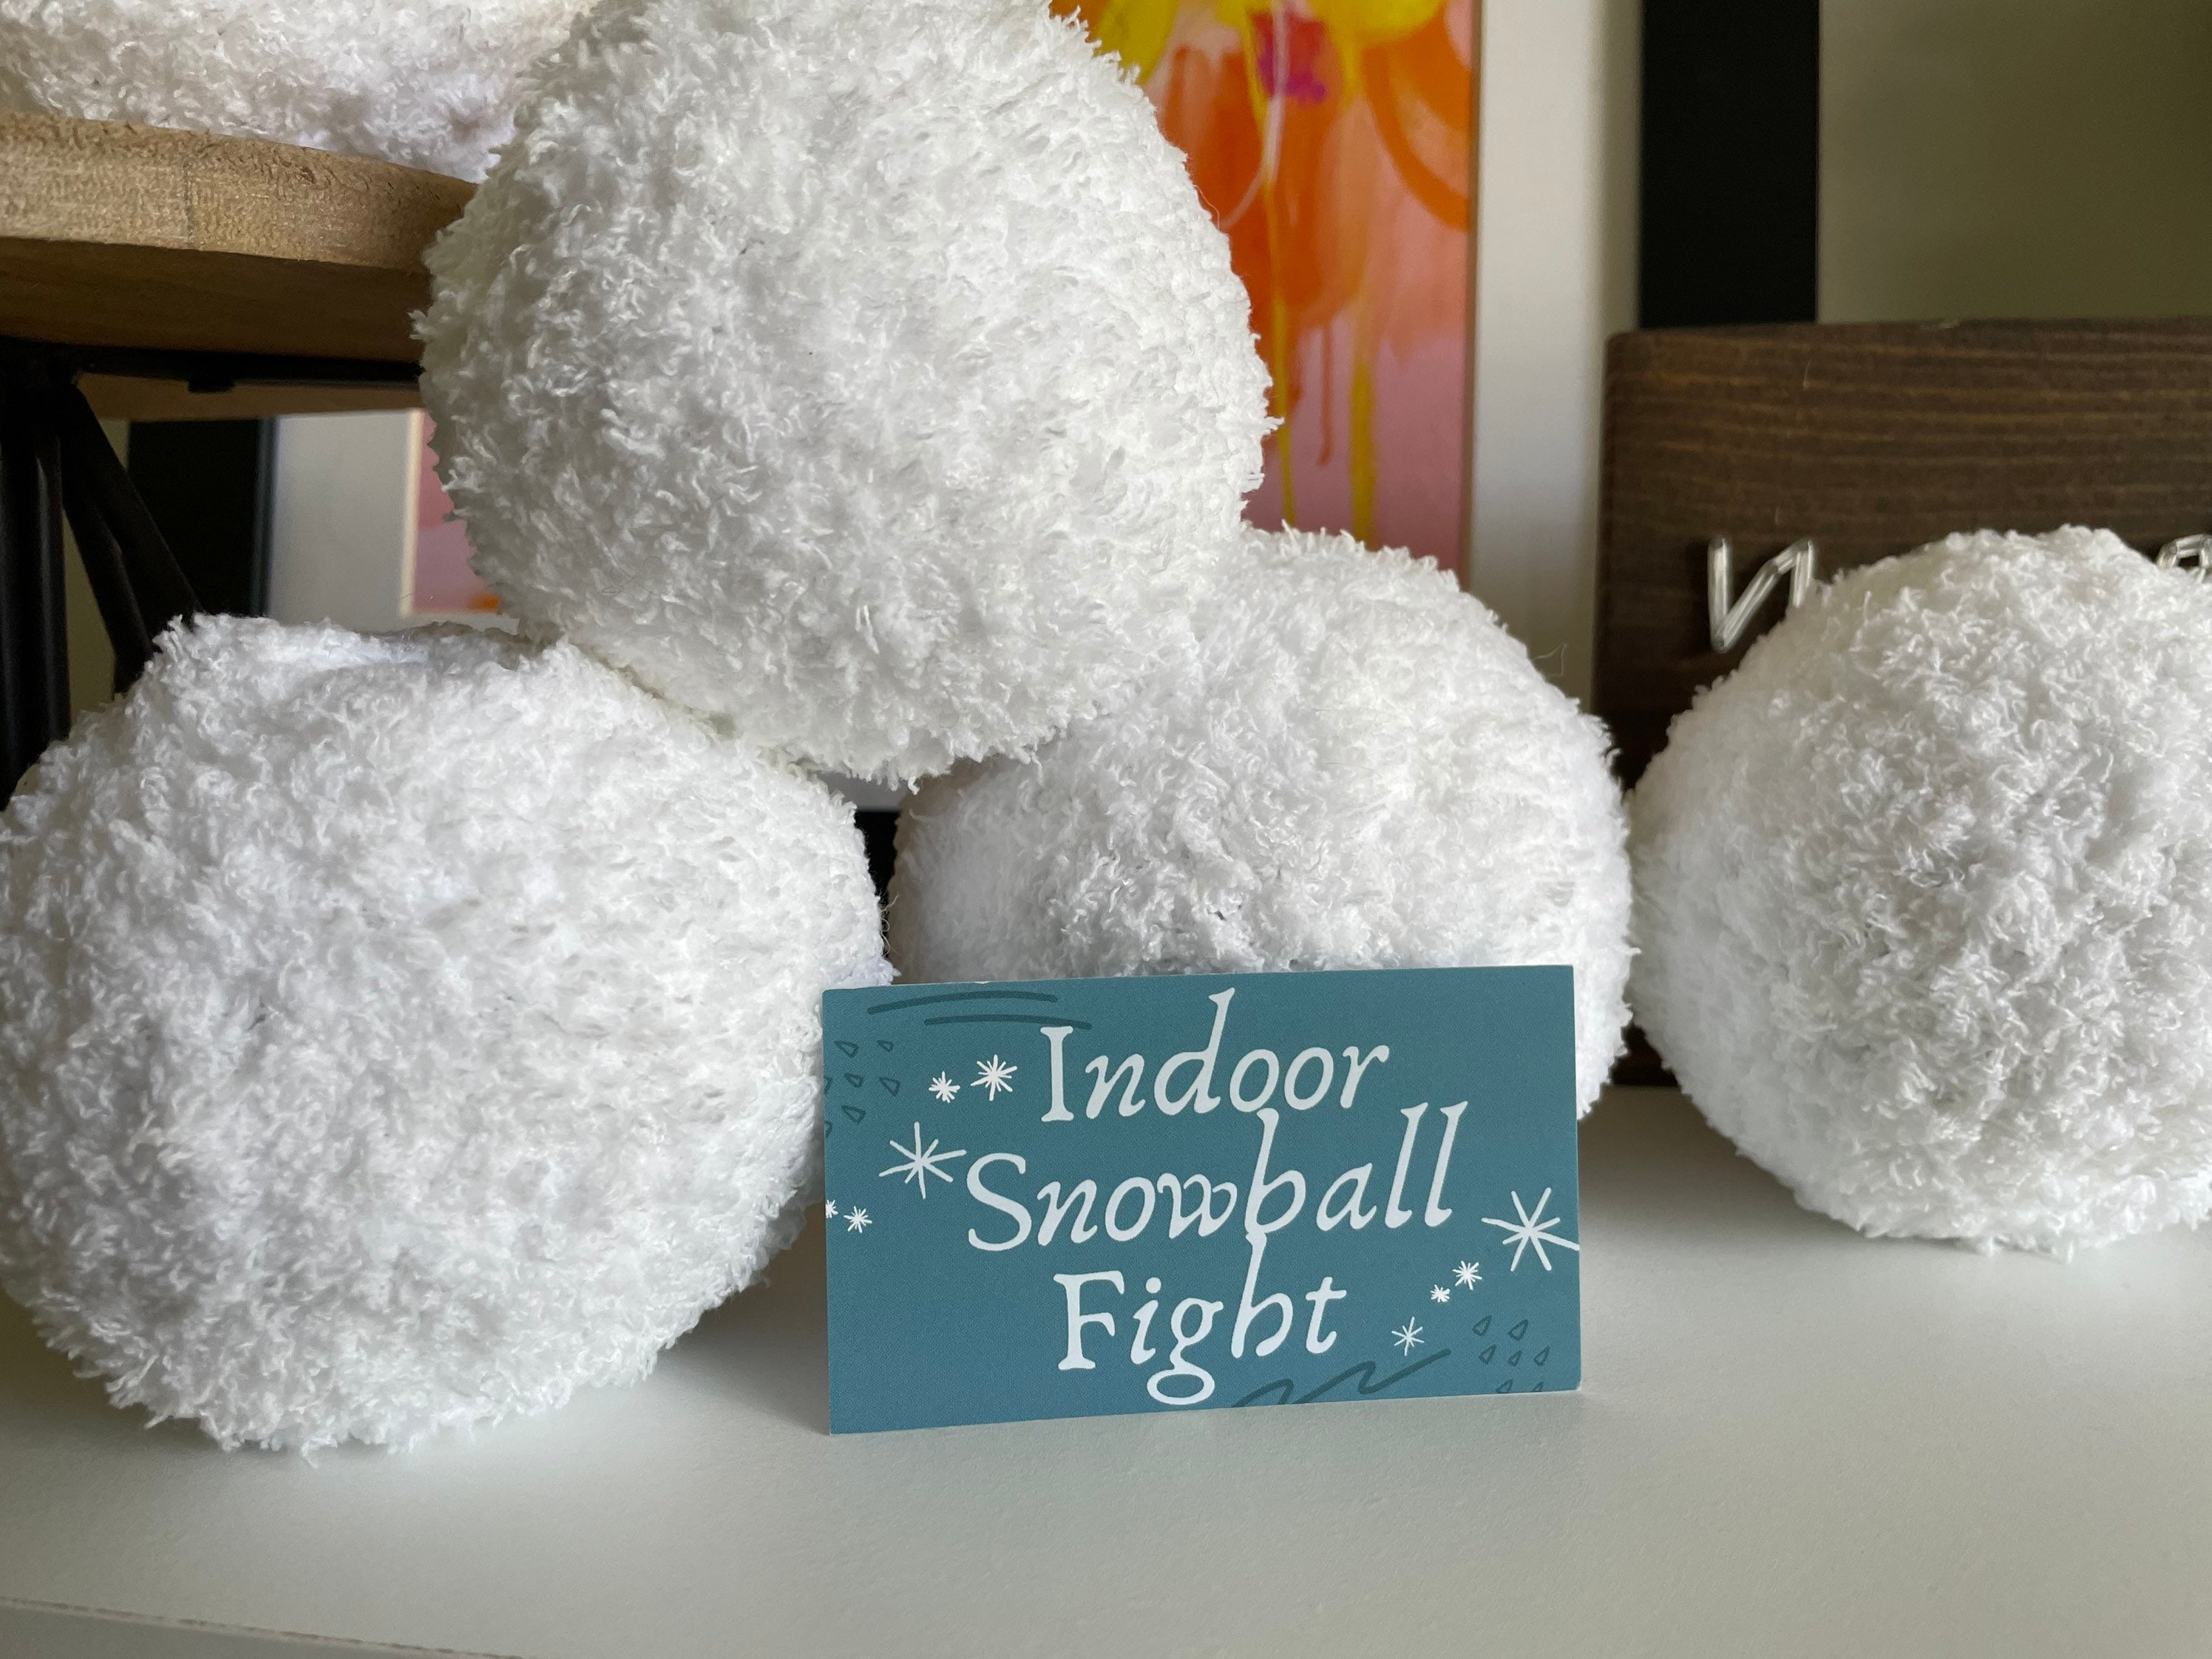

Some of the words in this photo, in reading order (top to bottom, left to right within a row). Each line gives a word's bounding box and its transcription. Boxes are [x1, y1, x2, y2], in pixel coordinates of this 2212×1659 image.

[1040, 988, 1390, 1122] Indoor
[966, 1102, 1468, 1252] Snowball
[1053, 1233, 1347, 1405] Fight
